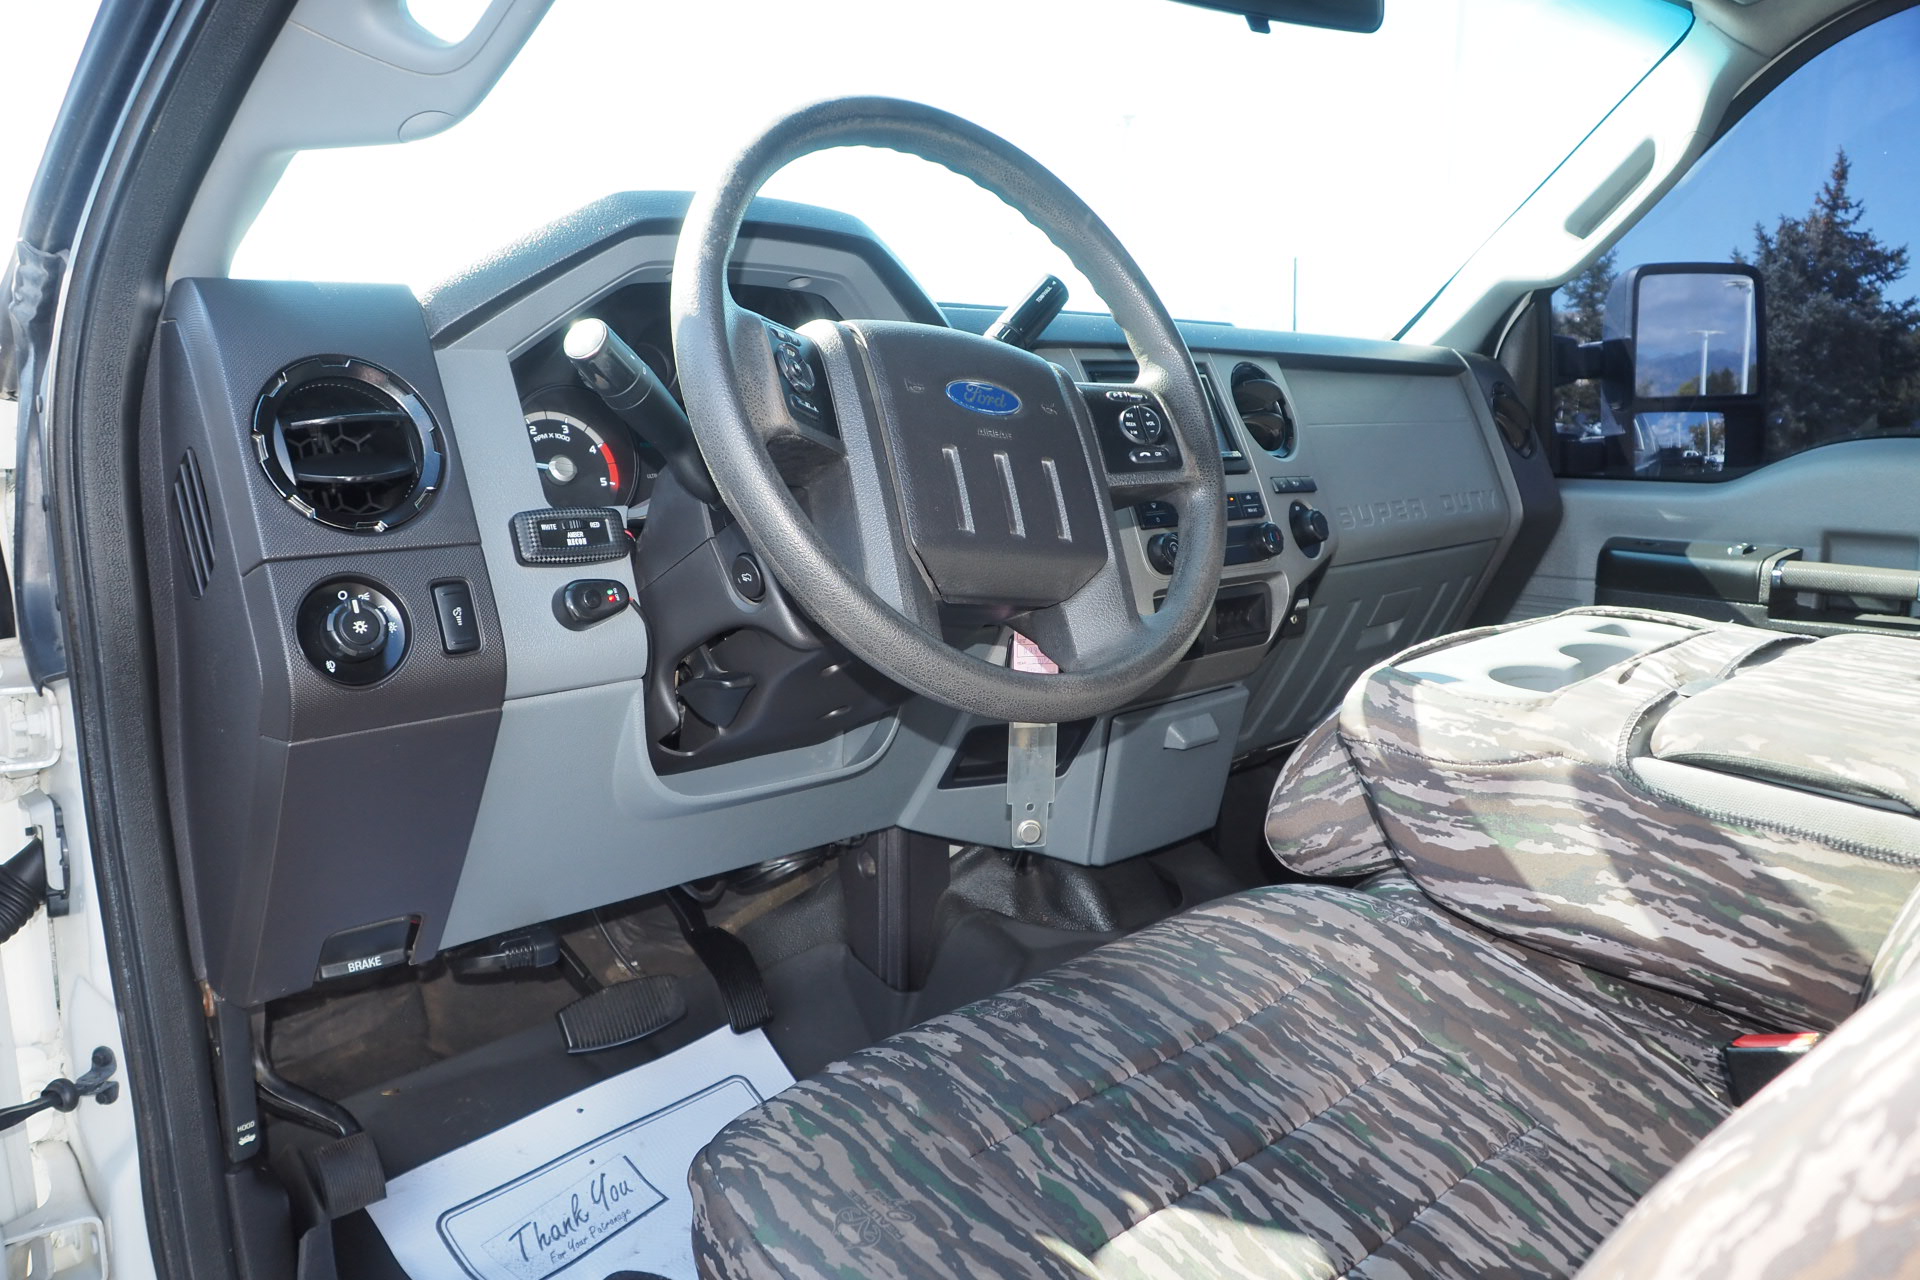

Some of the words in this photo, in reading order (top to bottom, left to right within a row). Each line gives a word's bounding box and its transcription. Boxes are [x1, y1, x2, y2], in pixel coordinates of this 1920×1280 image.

[963, 382, 1008, 409] Ford
[529, 426, 537, 435] 2
[561, 425, 569, 434] 3
[533, 432, 549, 443] RPM
[555, 432, 571, 442] 1000
[589, 445, 597, 454] 4
[599, 477, 608, 486] 5
[1336, 498, 1428, 530] SUPER
[1439, 489, 1496, 516] DUTY
[540, 523, 557, 531] WHITE
[567, 531, 584, 539] AMBER
[347, 955, 382, 973] BRAKE
[236, 1120, 255, 1133] HOOD
[508, 1193, 590, 1262] Thank
[590, 1172, 634, 1212] You
[549, 1250, 567, 1265] For
[567, 1235, 589, 1252] Your
[588, 1208, 632, 1239] Patronage
